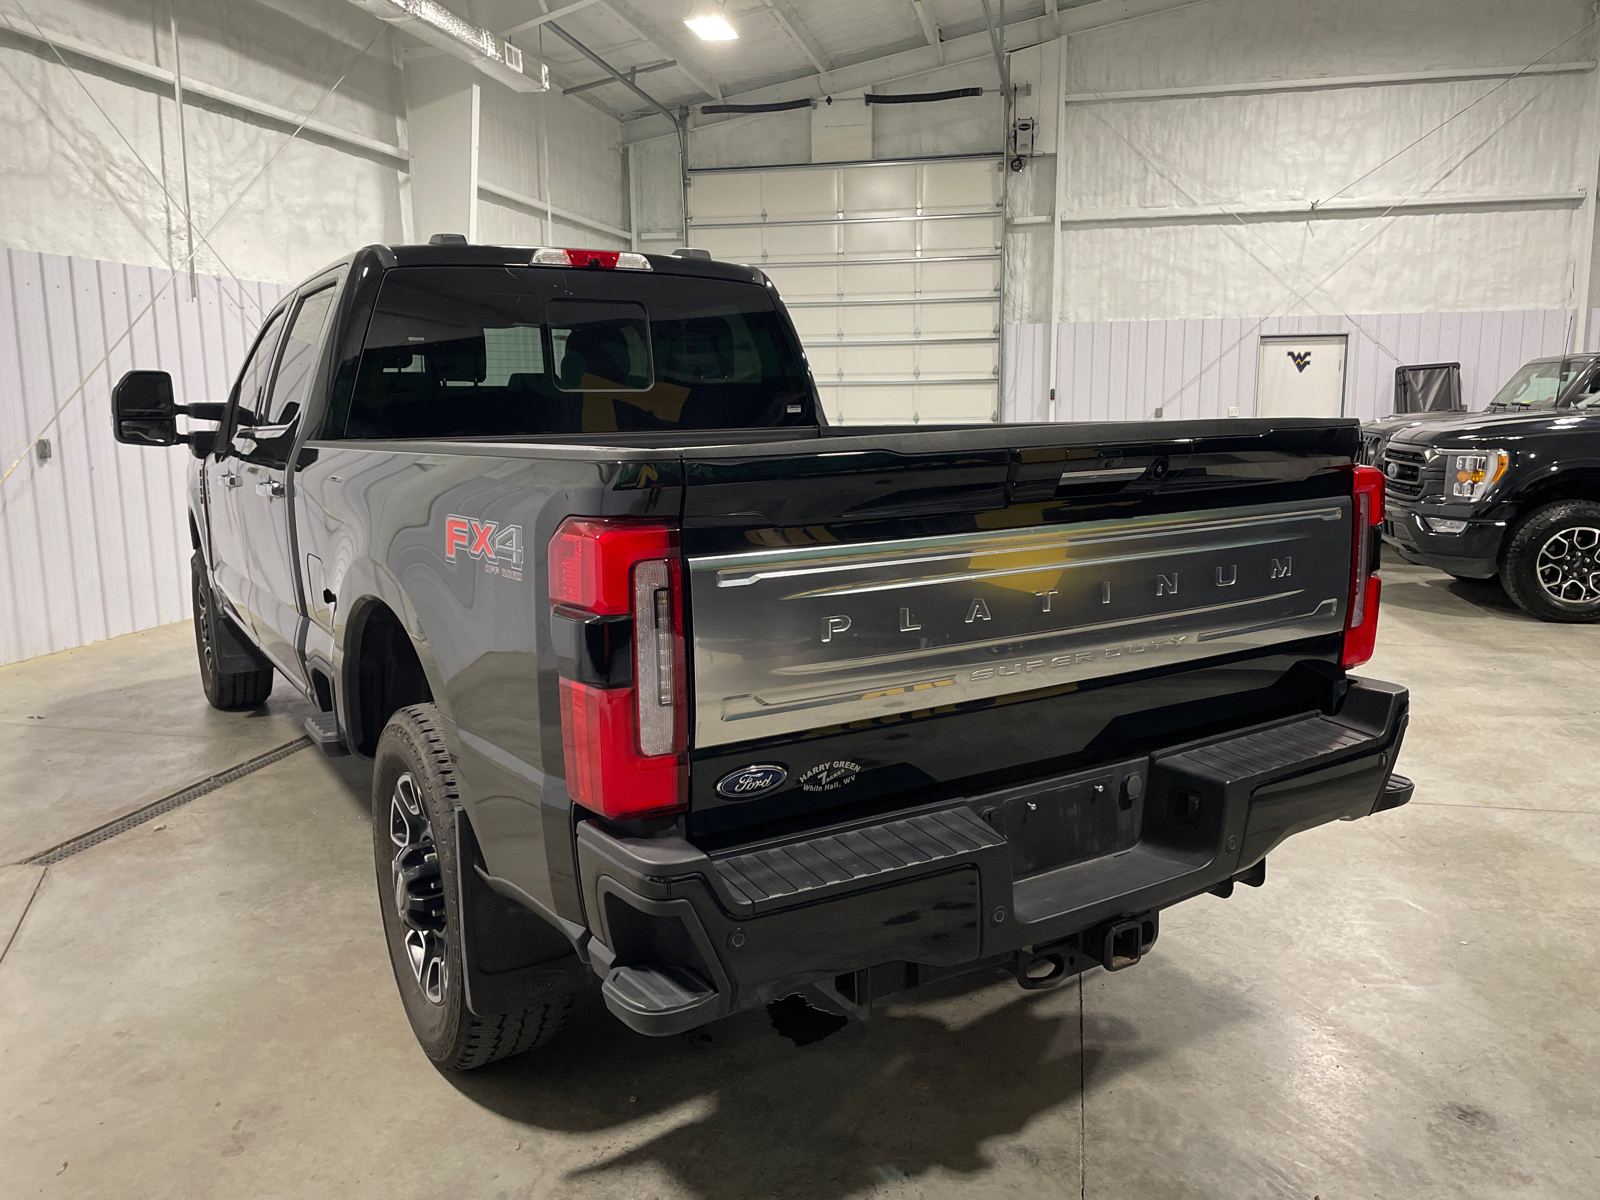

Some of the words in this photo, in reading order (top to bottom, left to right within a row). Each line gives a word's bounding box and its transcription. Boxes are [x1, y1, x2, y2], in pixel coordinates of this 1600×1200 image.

[445, 513, 523, 571] FX4
[820, 555, 1294, 643] PLATINUM
[971, 651, 1096, 682] SUPER
[1104, 635, 1188, 660] DUTY
[734, 771, 773, 793] Ford
[799, 762, 831, 783] HARRY
[833, 760, 861, 773] GREEN
[817, 771, 828, 785] 7
[826, 769, 845, 783] ACRES
[824, 781, 841, 791] Hall,
[843, 774, 856, 785] WV
